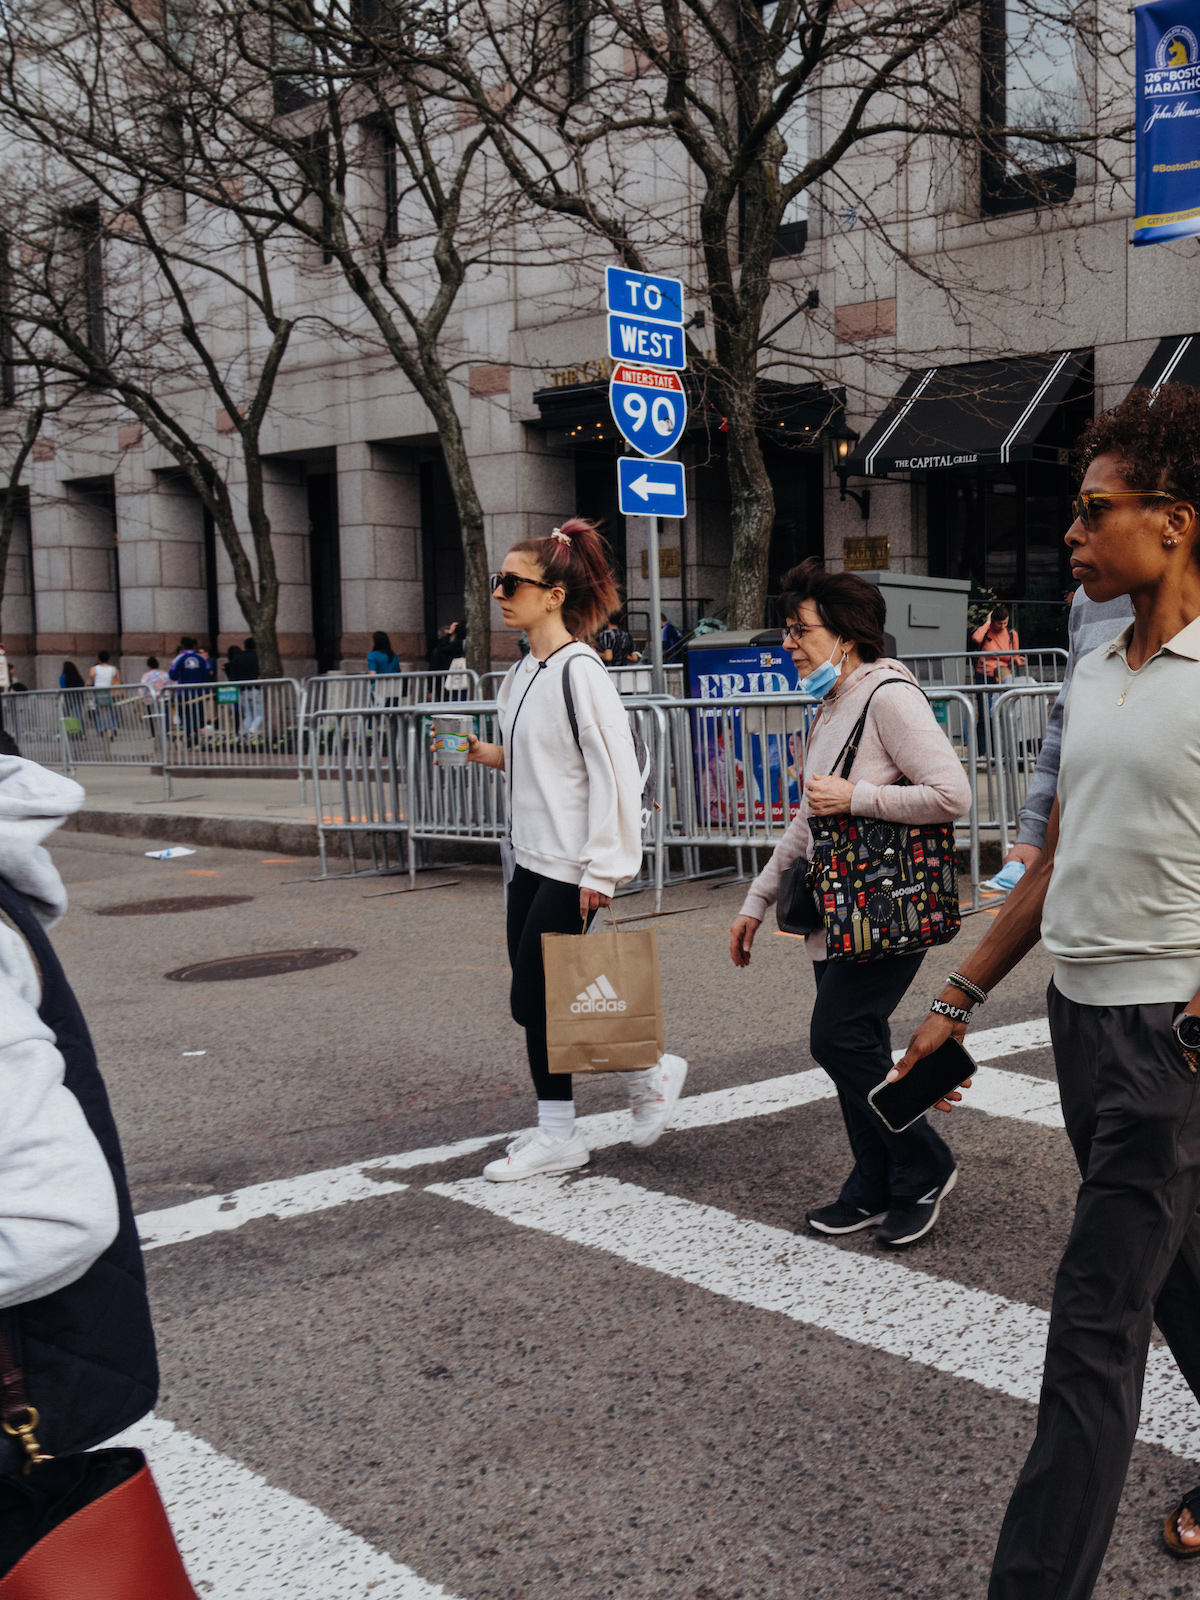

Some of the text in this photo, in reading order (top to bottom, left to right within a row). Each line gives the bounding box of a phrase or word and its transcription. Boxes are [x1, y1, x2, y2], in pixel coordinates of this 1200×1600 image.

[1143, 104, 1172, 133] John
[1147, 217, 1164, 225] CITY
[1165, 215, 1176, 223] OF
[625, 280, 662, 311] TO
[620, 324, 673, 359] WEST
[621, 370, 674, 389] INTERSTATE
[623, 392, 676, 437] 90
[895, 454, 978, 469] THE CAPITAL GRILLE
[891, 881, 926, 899] LONDON
[570, 998, 627, 1014] adidas
